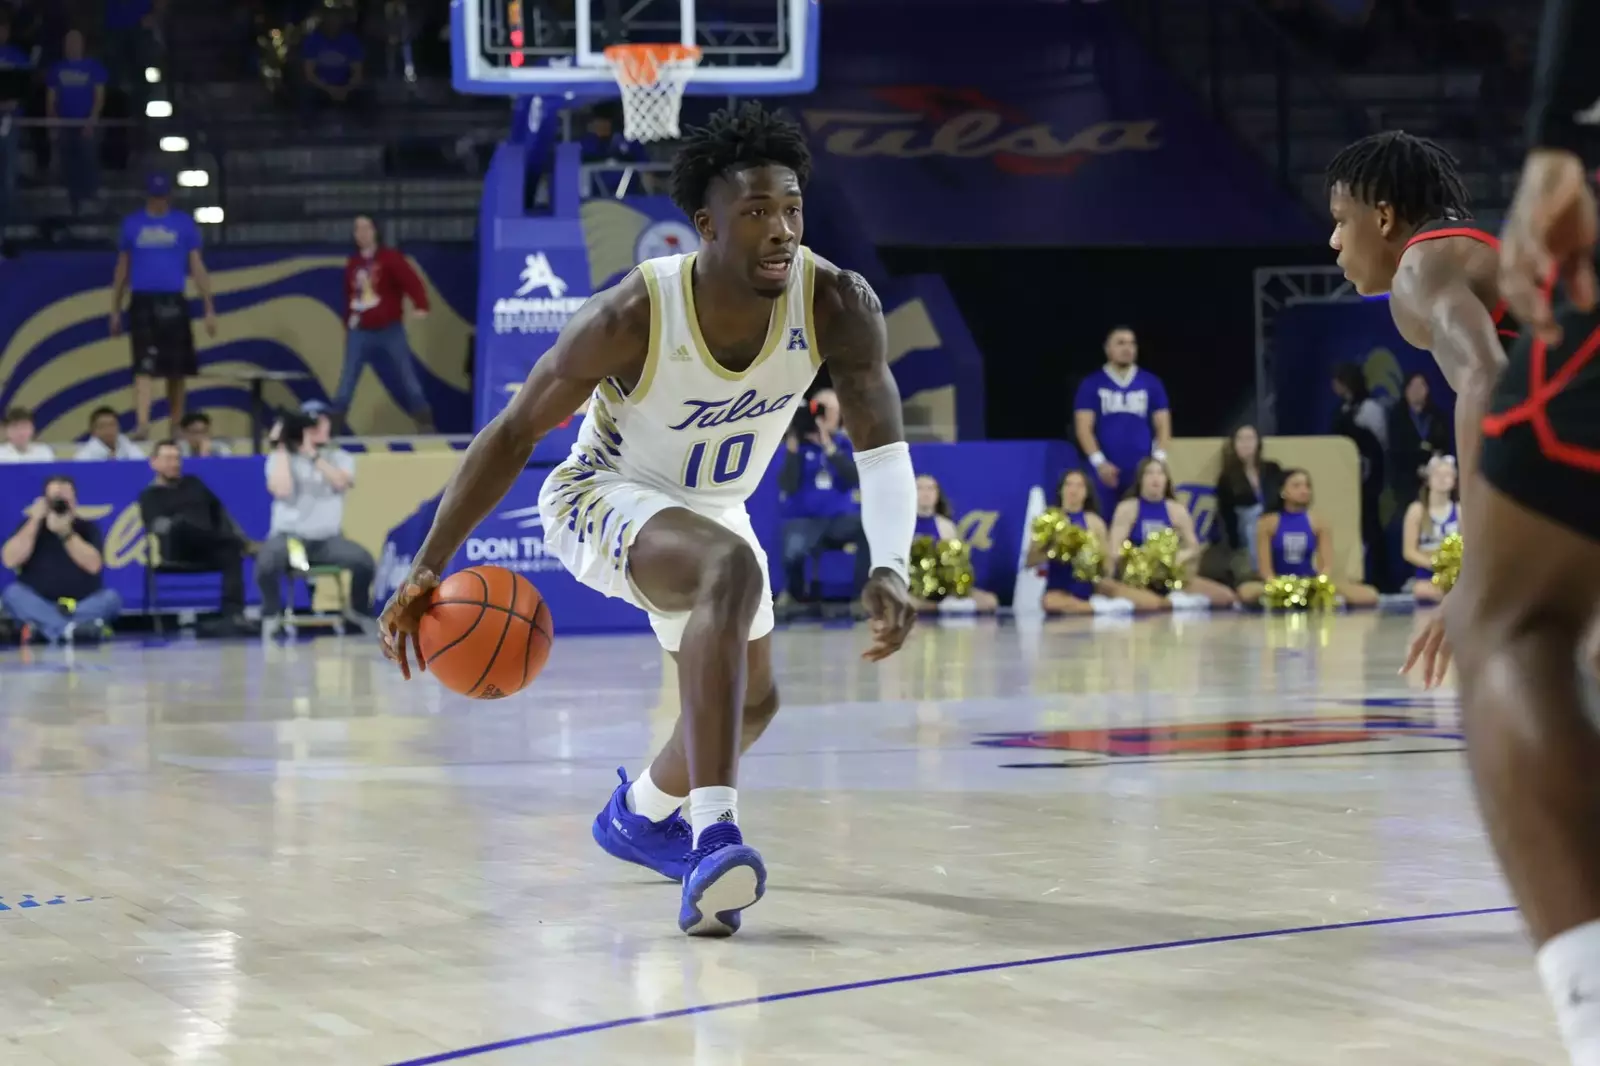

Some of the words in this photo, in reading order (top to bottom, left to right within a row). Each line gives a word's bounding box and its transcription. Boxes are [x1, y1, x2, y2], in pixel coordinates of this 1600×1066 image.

[668, 389, 796, 430] Tulsa
[681, 431, 757, 488] 10
[466, 537, 518, 561] DON
